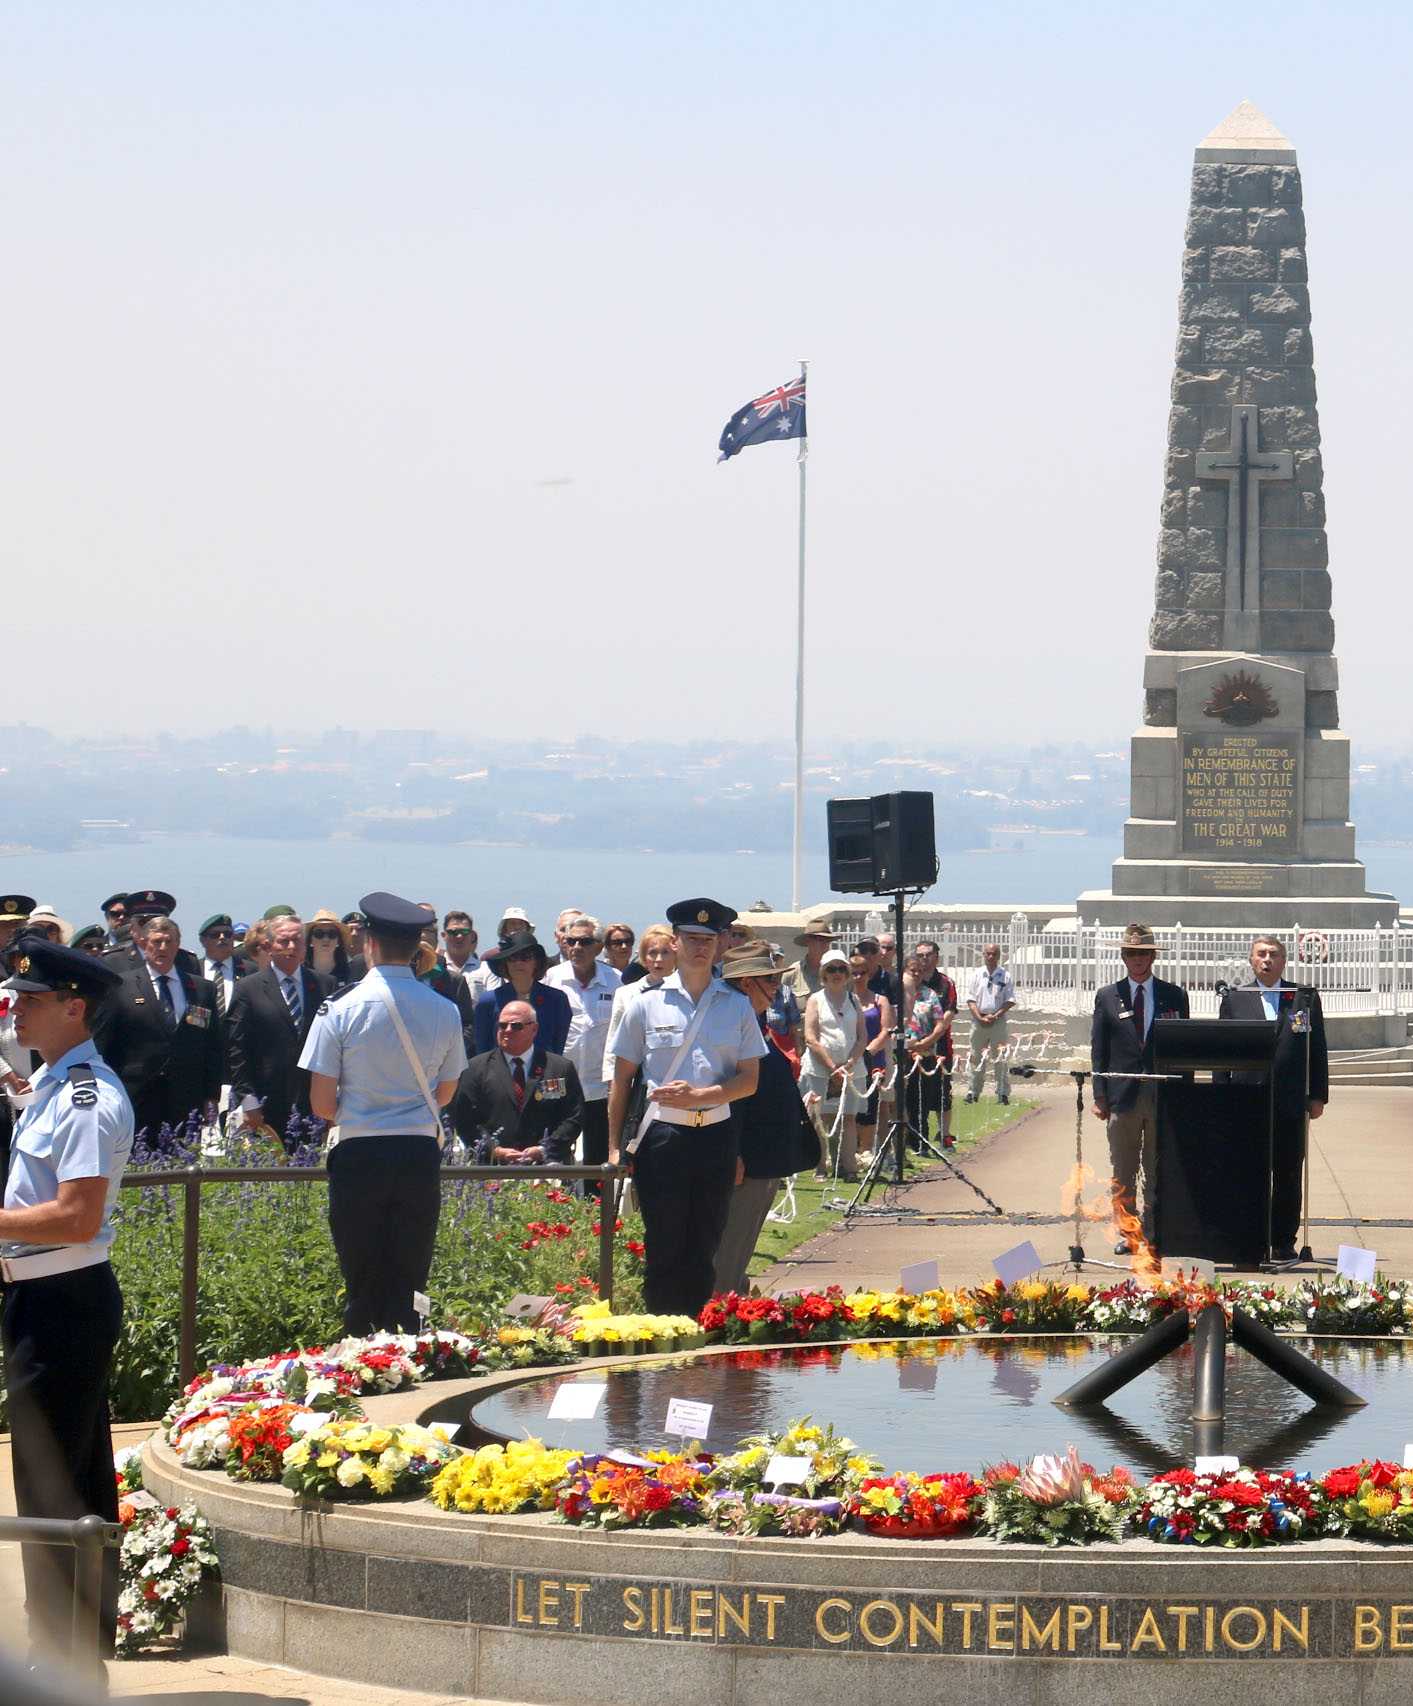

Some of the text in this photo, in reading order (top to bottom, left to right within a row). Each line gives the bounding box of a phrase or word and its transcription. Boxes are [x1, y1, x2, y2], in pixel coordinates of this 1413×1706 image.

[1192, 748, 1289, 757] BY GRATEFUL CITIZENS
[1184, 759, 1296, 770] IN REMEMBRANCE OF
[1186, 772, 1293, 787] MEN OF THIS STATE
[1187, 788, 1294, 797] WHO AT THE CALL OF DUTY
[1192, 799, 1287, 808] GAVE THEIR LIVES FOR
[1185, 809, 1294, 817] FREEDOM AND HUMANITY
[1193, 823, 1287, 837] THE GREAT WAR
[1216, 839, 1234, 848] 1914
[1243, 839, 1263, 848] 1918
[515, 1579, 591, 1627] LET
[622, 1586, 786, 1640] SILENT
[815, 1597, 1309, 1653] CONTEMPLATION
